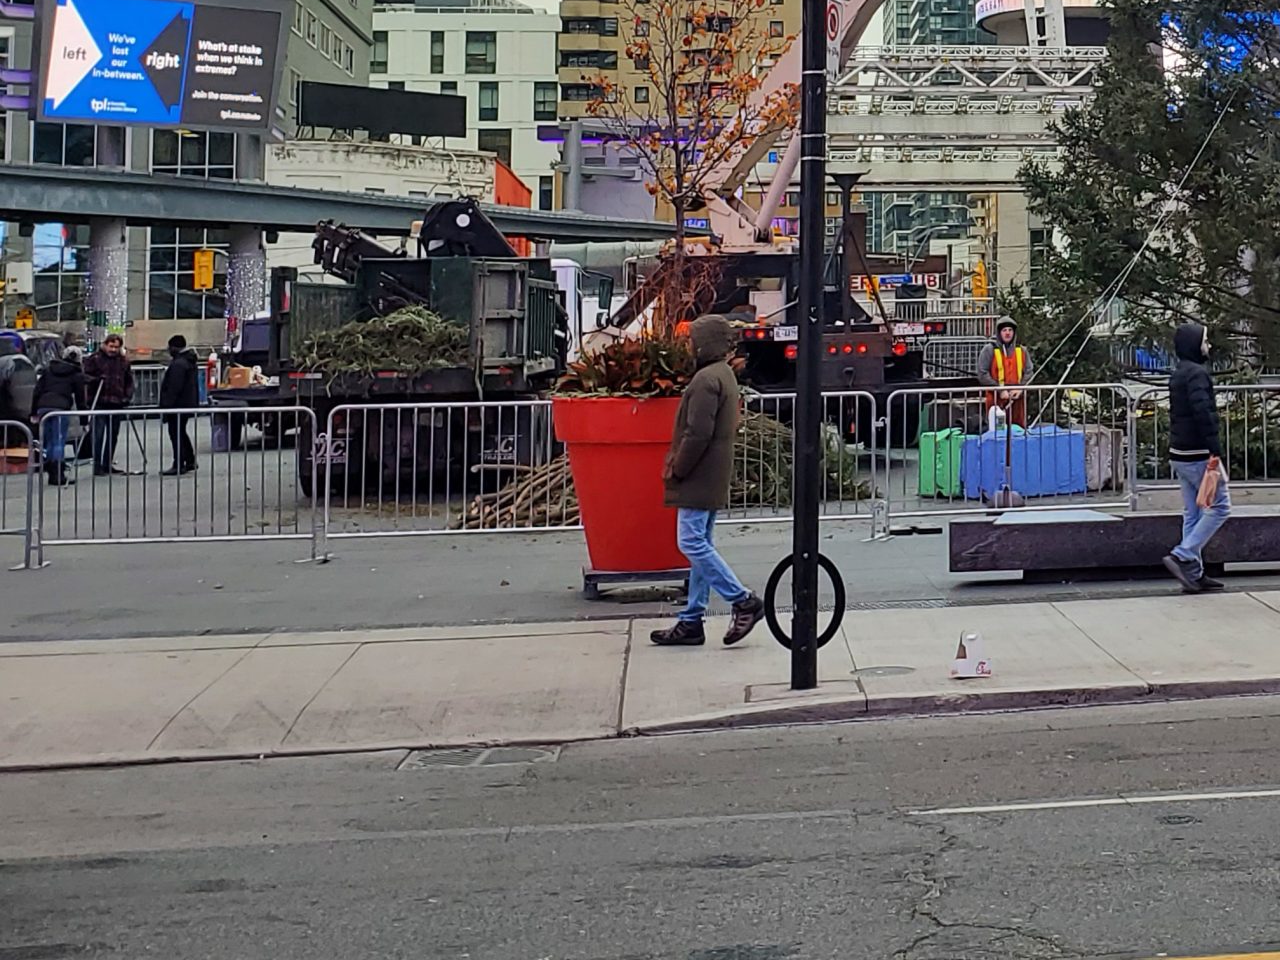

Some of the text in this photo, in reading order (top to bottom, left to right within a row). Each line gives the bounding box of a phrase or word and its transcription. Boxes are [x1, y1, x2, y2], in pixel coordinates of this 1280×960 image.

[109, 32, 136, 44] We've
[62, 46, 87, 61] left
[199, 40, 262, 55] What's at stake
[146, 51, 180, 70] right
[196, 52, 220, 62] when
[111, 59, 127, 68] our
[195, 65, 237, 75] extremes?
